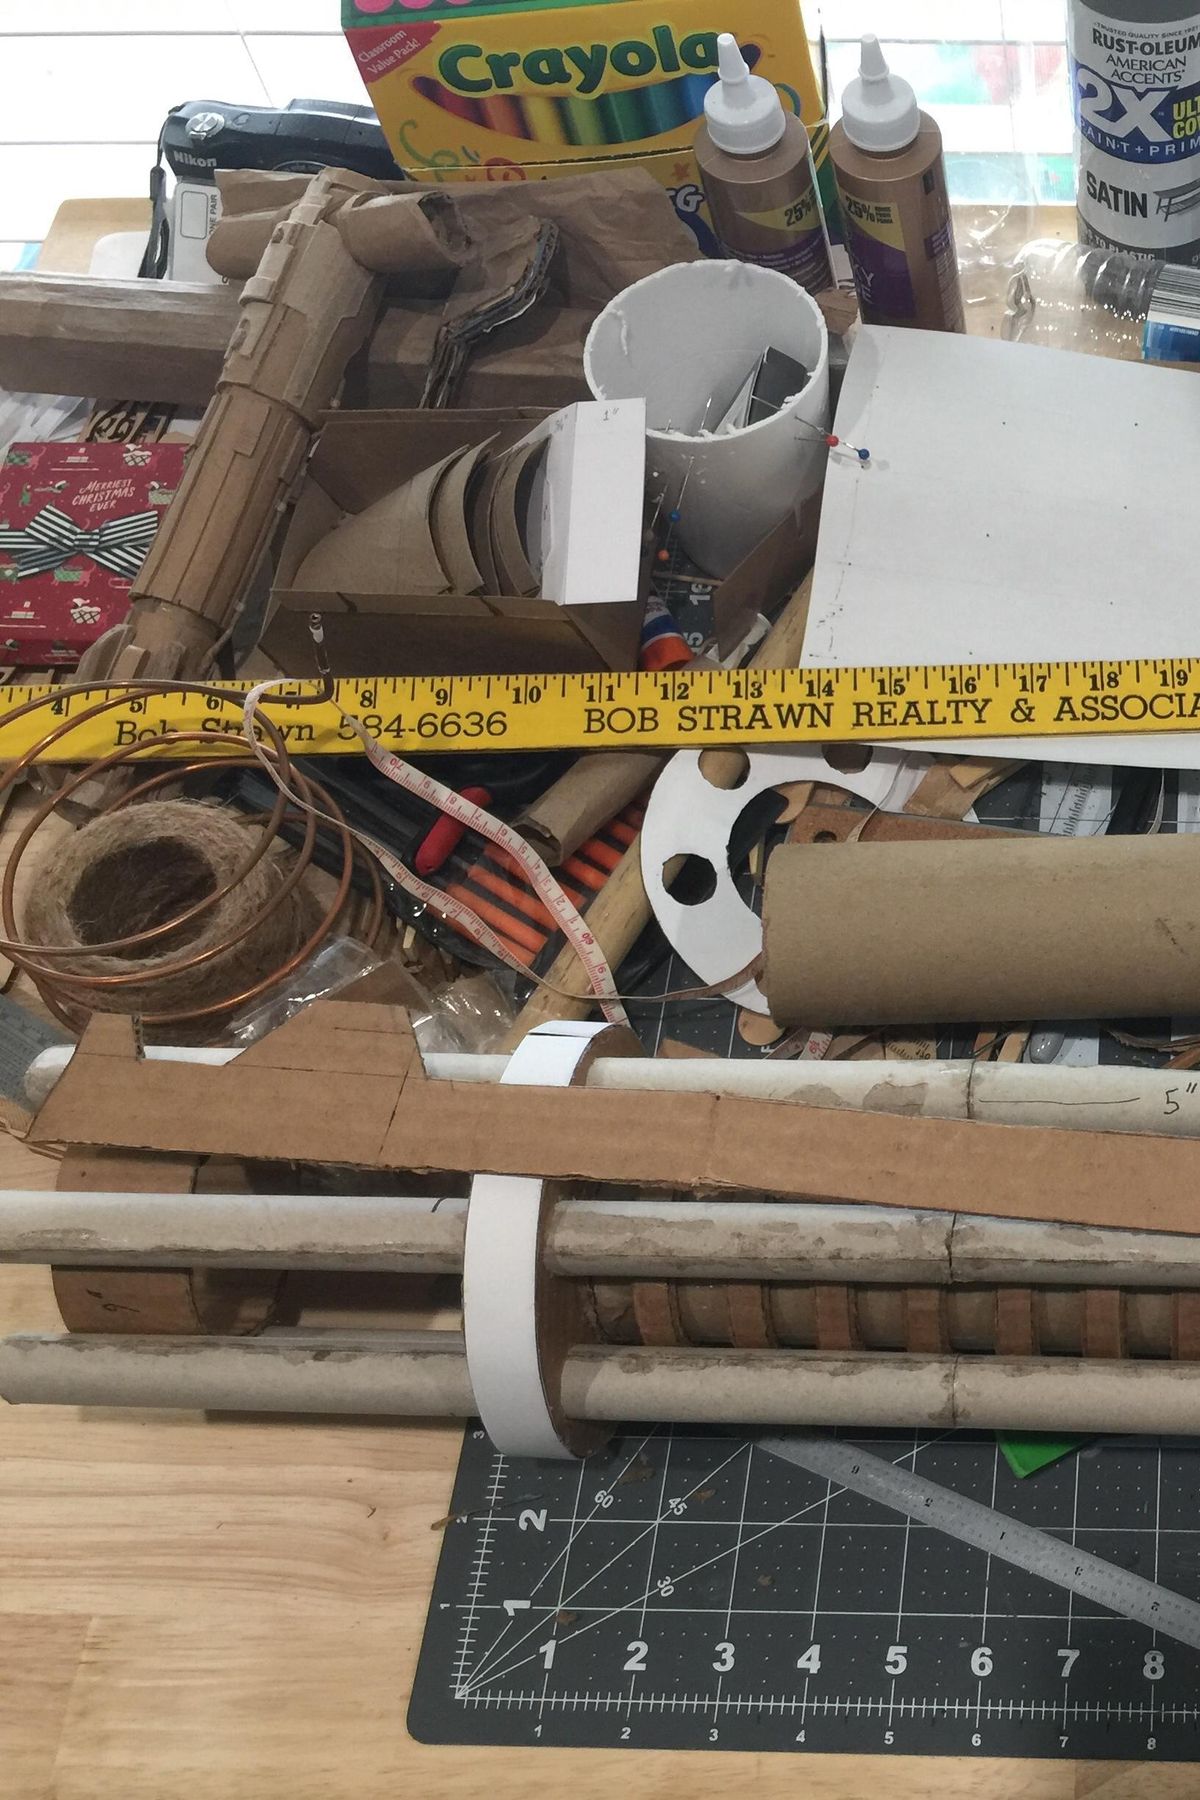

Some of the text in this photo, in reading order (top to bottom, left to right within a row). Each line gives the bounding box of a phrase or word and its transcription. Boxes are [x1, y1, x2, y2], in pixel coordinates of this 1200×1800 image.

[358, 30, 407, 62] Classroom
[1161, 30, 1181, 38] SINCE
[367, 38, 421, 74] Value Pack!
[439, 25, 724, 93] Crayola
[1106, 54, 1187, 71] AMERICAN
[1111, 69, 1183, 84] ACCENTS
[1077, 68, 1173, 142] 2X
[1080, 119, 1130, 153] PAINT
[173, 151, 217, 167] Nikon
[210, 194, 218, 219] PAIR
[1086, 170, 1148, 218] SATIN
[846, 195, 875, 222] 25%
[72, 486, 137, 507] CHRISTMAS
[79, 478, 134, 496] MERRIEST
[89, 500, 117, 513] EVER
[129, 697, 143, 713] 5
[206, 695, 220, 710] 6
[360, 690, 374, 708] 8
[435, 688, 449, 706] 9
[511, 686, 542, 704] 10
[585, 684, 616, 702] 11
[660, 682, 690, 700] 12
[732, 680, 764, 699] 13
[805, 679, 835, 697] 14
[877, 677, 906, 695] 15
[948, 676, 977, 694] 16
[1019, 674, 1048, 693] 17
[1089, 673, 1120, 691] 18
[1159, 669, 1189, 687] 19
[337, 711, 508, 741] 584-6636
[583, 707, 660, 734] BOB
[677, 703, 835, 732] STRAWN
[852, 698, 993, 728] REALTY
[1010, 697, 1036, 723] &
[114, 717, 315, 747] Bob Strawn
[1163, 1082, 1199, 1115] 5"
[473, 1429, 486, 1440] 3
[594, 1489, 615, 1509] 60
[668, 1496, 688, 1516] 45
[518, 1508, 548, 1532] 2
[657, 1575, 675, 1598] 30
[502, 1599, 532, 1617] 1
[539, 1640, 557, 1670] 1
[623, 1641, 649, 1671] 2
[712, 1642, 736, 1673] 3
[796, 1644, 822, 1674] 4
[884, 1646, 908, 1675] 5
[970, 1647, 994, 1677] 6
[1057, 1649, 1081, 1677] 7
[1142, 1650, 1166, 1680] 8
[533, 1725, 543, 1738] 1
[620, 1726, 632, 1740] 2
[708, 1728, 719, 1742] 3
[796, 1729, 806, 1743] 4
[883, 1731, 894, 1745] 5
[971, 1733, 982, 1747] 6
[1059, 1735, 1069, 1748] 7
[1146, 1737, 1157, 1750] 8
